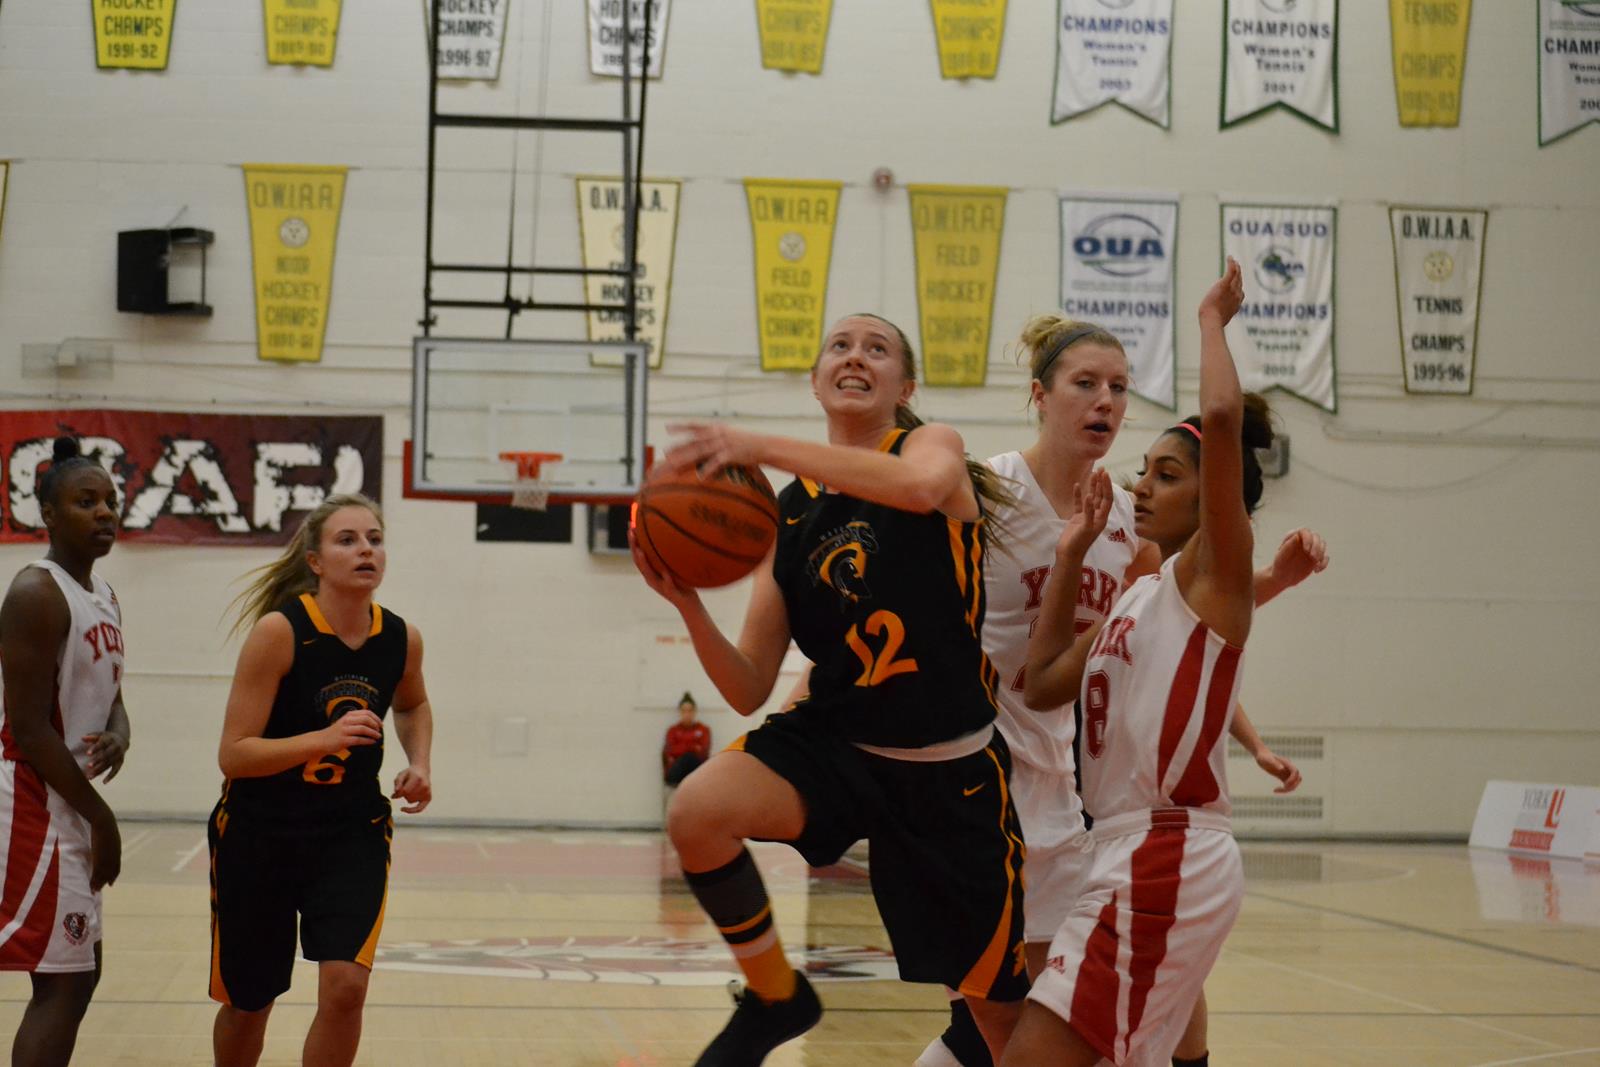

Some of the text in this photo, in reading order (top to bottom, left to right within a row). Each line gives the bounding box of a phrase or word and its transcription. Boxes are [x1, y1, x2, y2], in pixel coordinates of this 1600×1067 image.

[104, 15, 163, 37] CHAMPS
[1063, 16, 1168, 34] CHAMPIONS
[1231, 20, 1330, 39] CHAMPIONS
[1256, 59, 1305, 72] Tennis
[1073, 236, 1165, 258] OUA
[1065, 298, 1169, 319] CHAMPIONS
[1238, 302, 1328, 320] HAMPIONS
[1414, 296, 1463, 315] TENNIS
[1411, 333, 1465, 353] CHAMPS
[1413, 362, 1465, 382] 1995-96
[1084, 669, 1111, 761] 8
